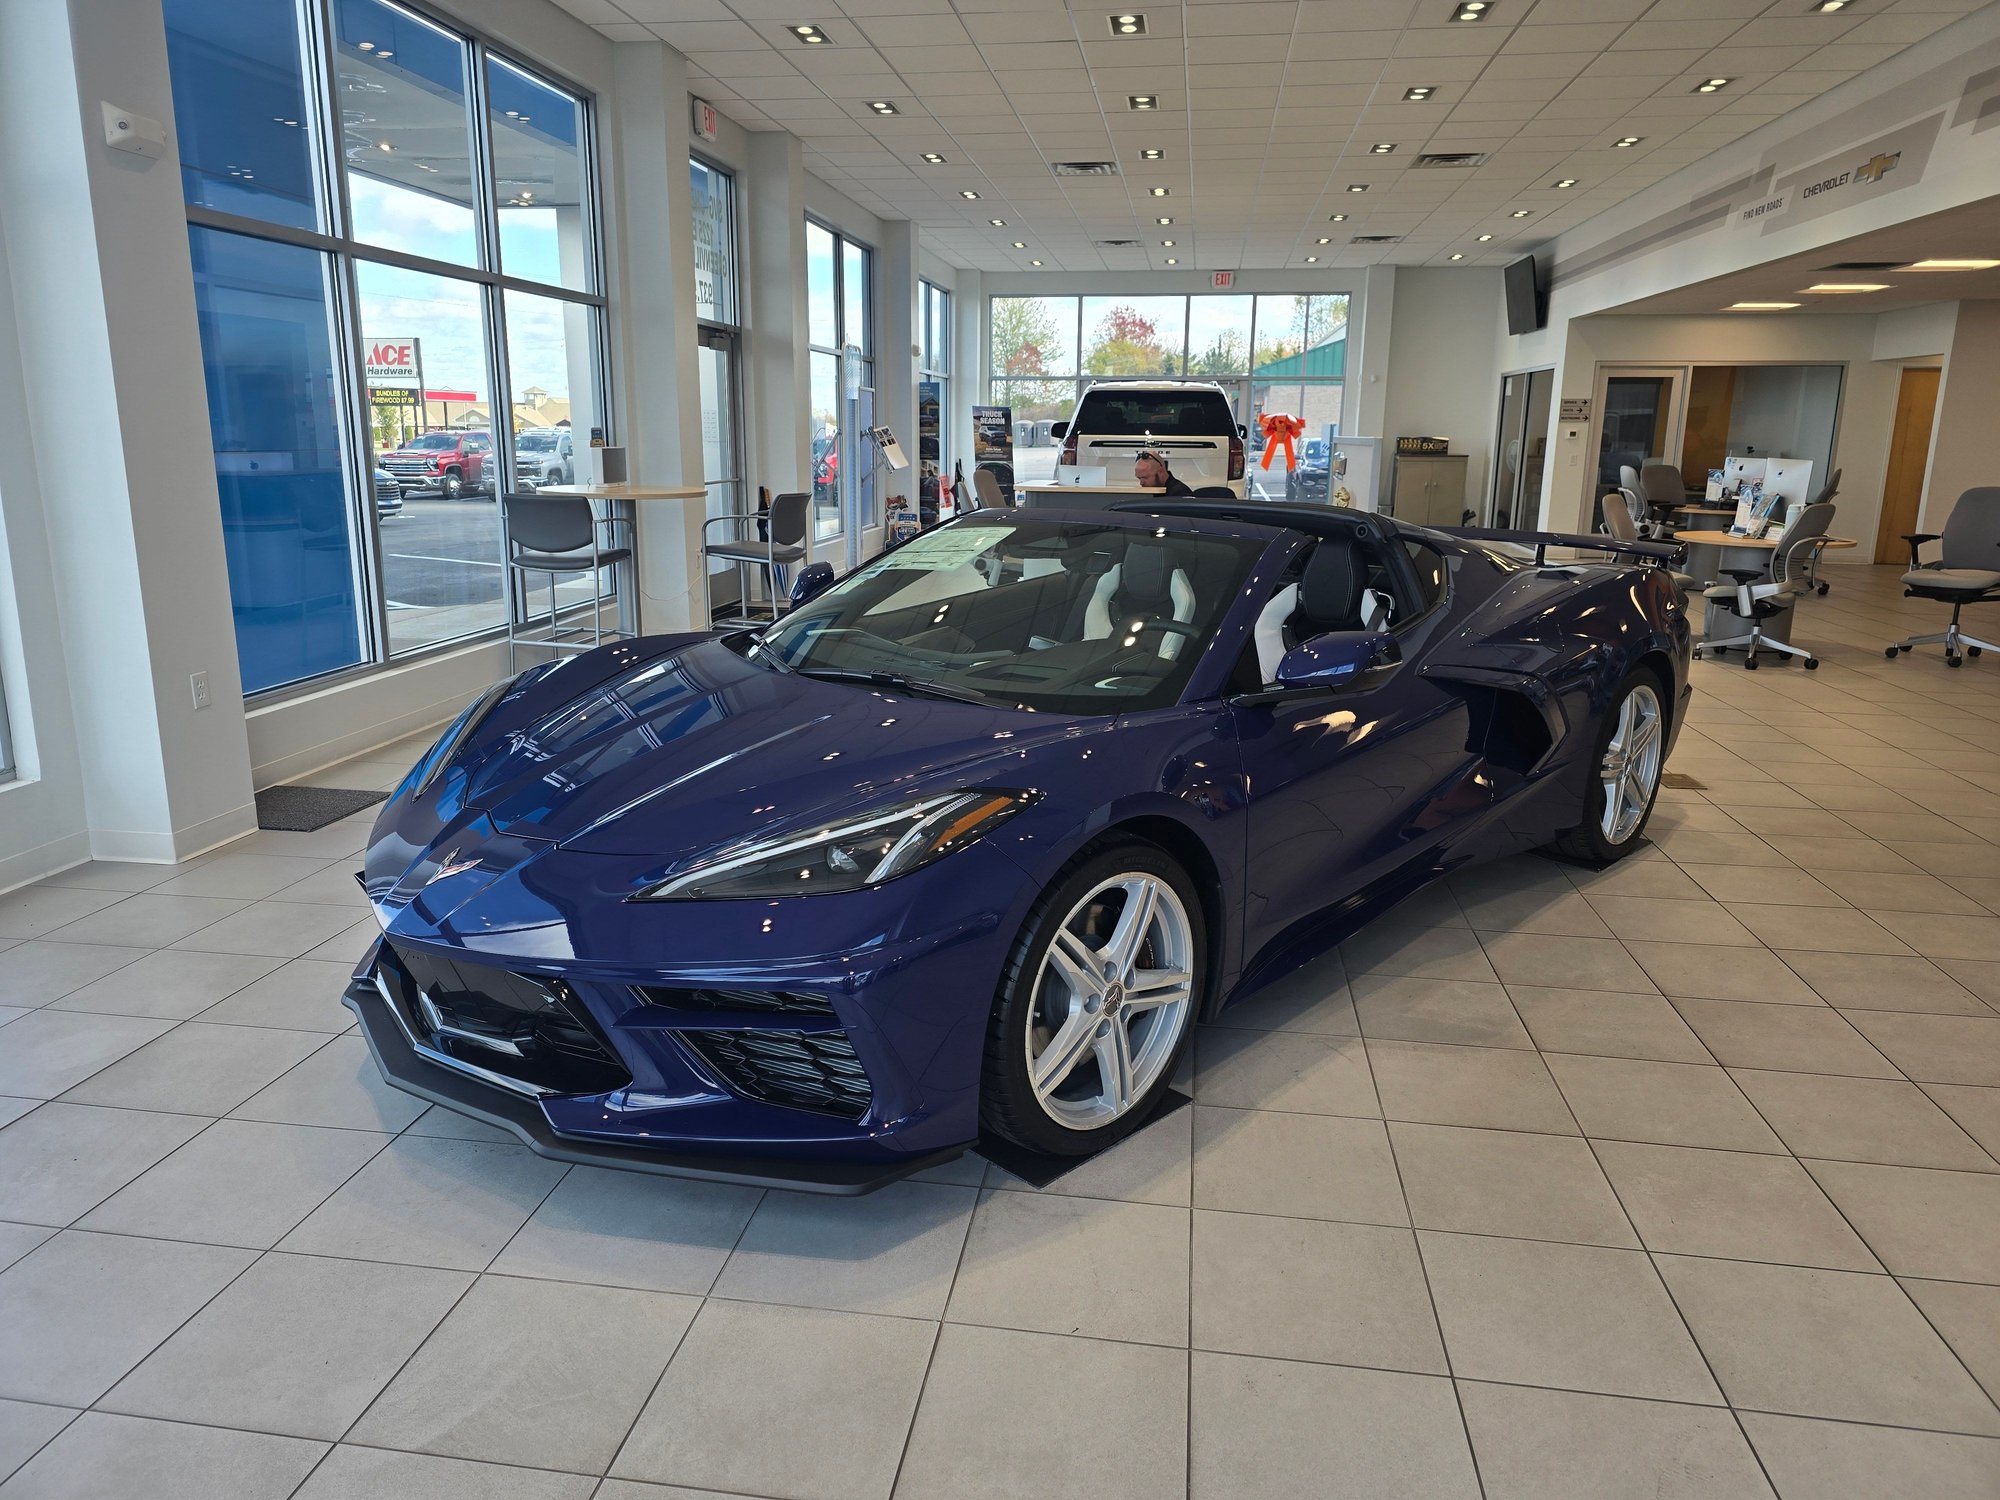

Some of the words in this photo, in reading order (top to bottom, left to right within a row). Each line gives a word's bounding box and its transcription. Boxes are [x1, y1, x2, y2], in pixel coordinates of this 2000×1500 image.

[703, 105, 716, 136] EXIT
[1803, 172, 1851, 199] CHEVROLET
[1743, 209, 1754, 220] FIND
[1755, 204, 1767, 217] NEW
[1766, 197, 1783, 212] ROADS
[1215, 272, 1231, 286] EXIT
[366, 342, 411, 366] ACE
[367, 366, 413, 375] Hardware
[979, 417, 1006, 425] SEASON
[981, 410, 1003, 418] TRUCK
